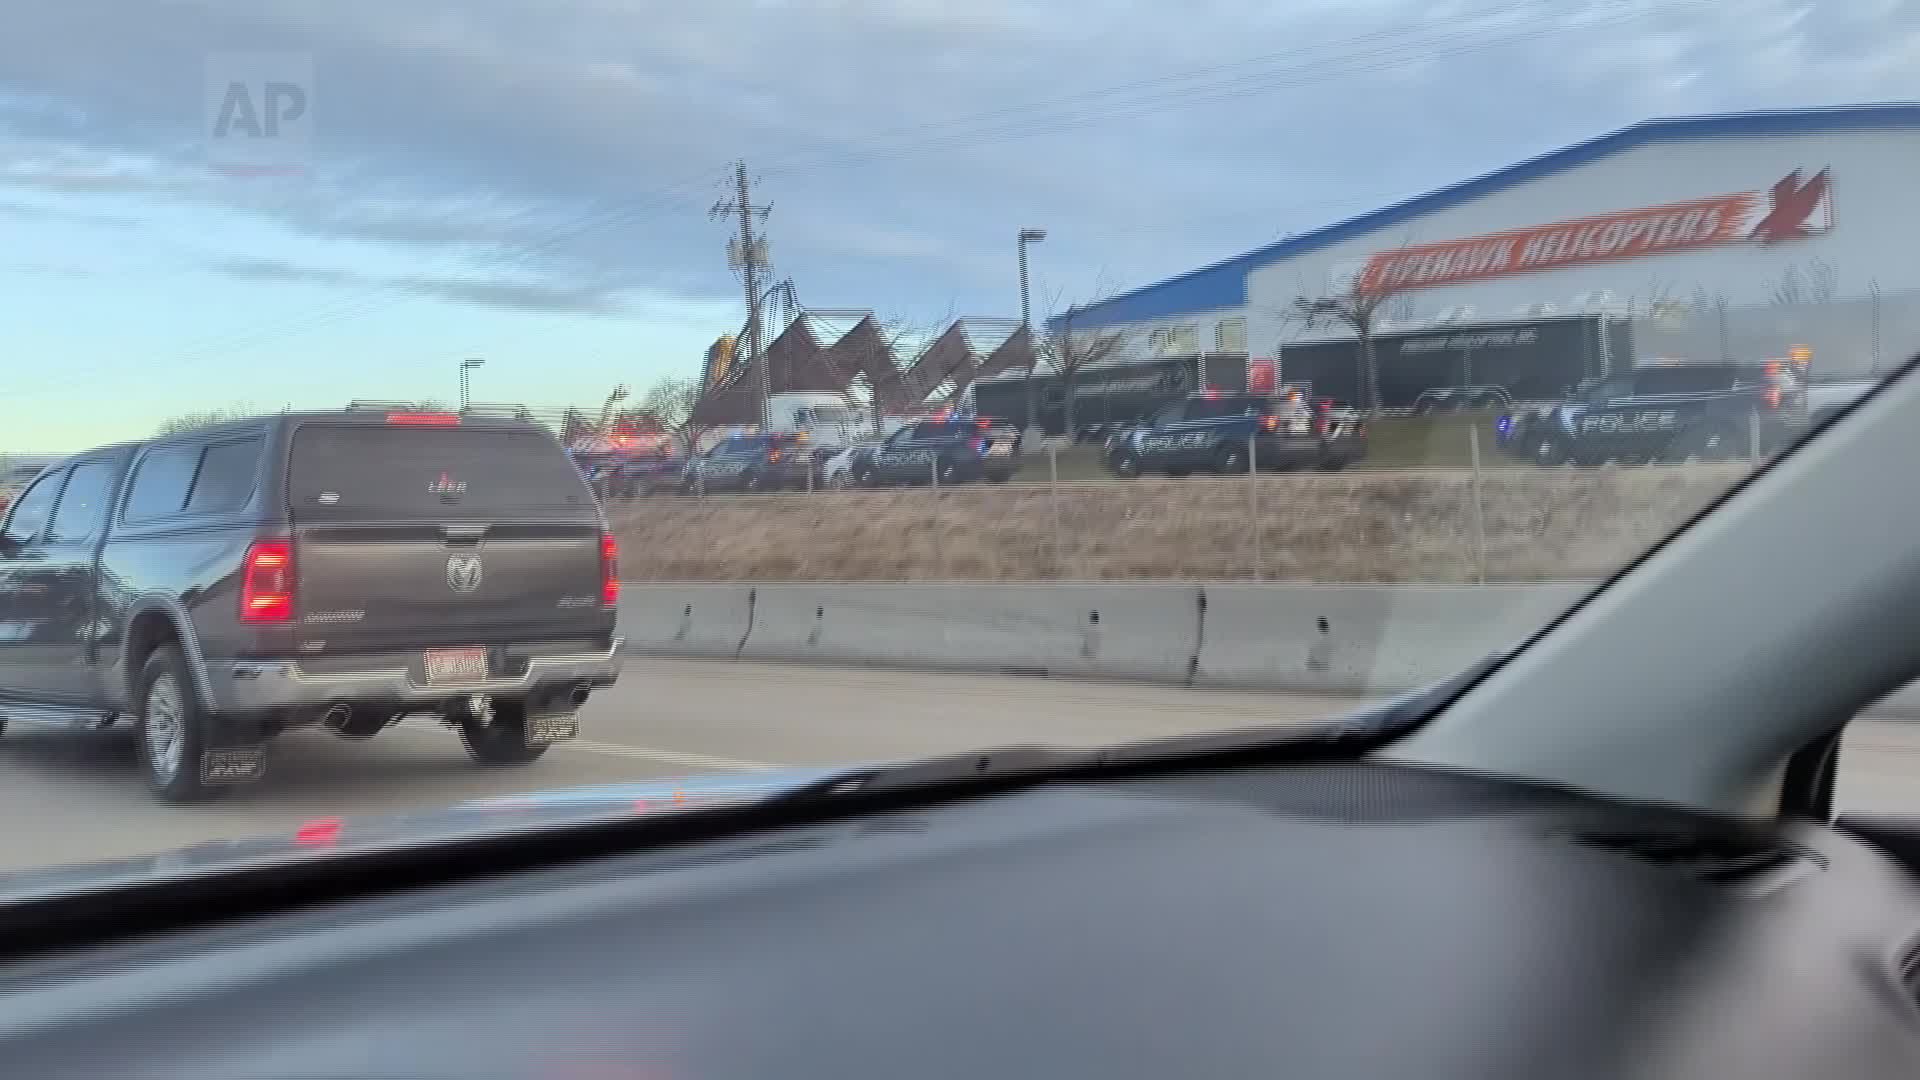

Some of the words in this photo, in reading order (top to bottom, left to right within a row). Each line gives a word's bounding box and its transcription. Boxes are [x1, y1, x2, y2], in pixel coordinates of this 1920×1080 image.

[1376, 238, 1516, 286] FIREHAWK
[1518, 204, 1726, 266] HELICOPTERS
[1582, 409, 1678, 433] POLICE
[1146, 430, 1206, 453] POLICE
[883, 449, 929, 467] POLICE
[427, 480, 468, 495] LEER
